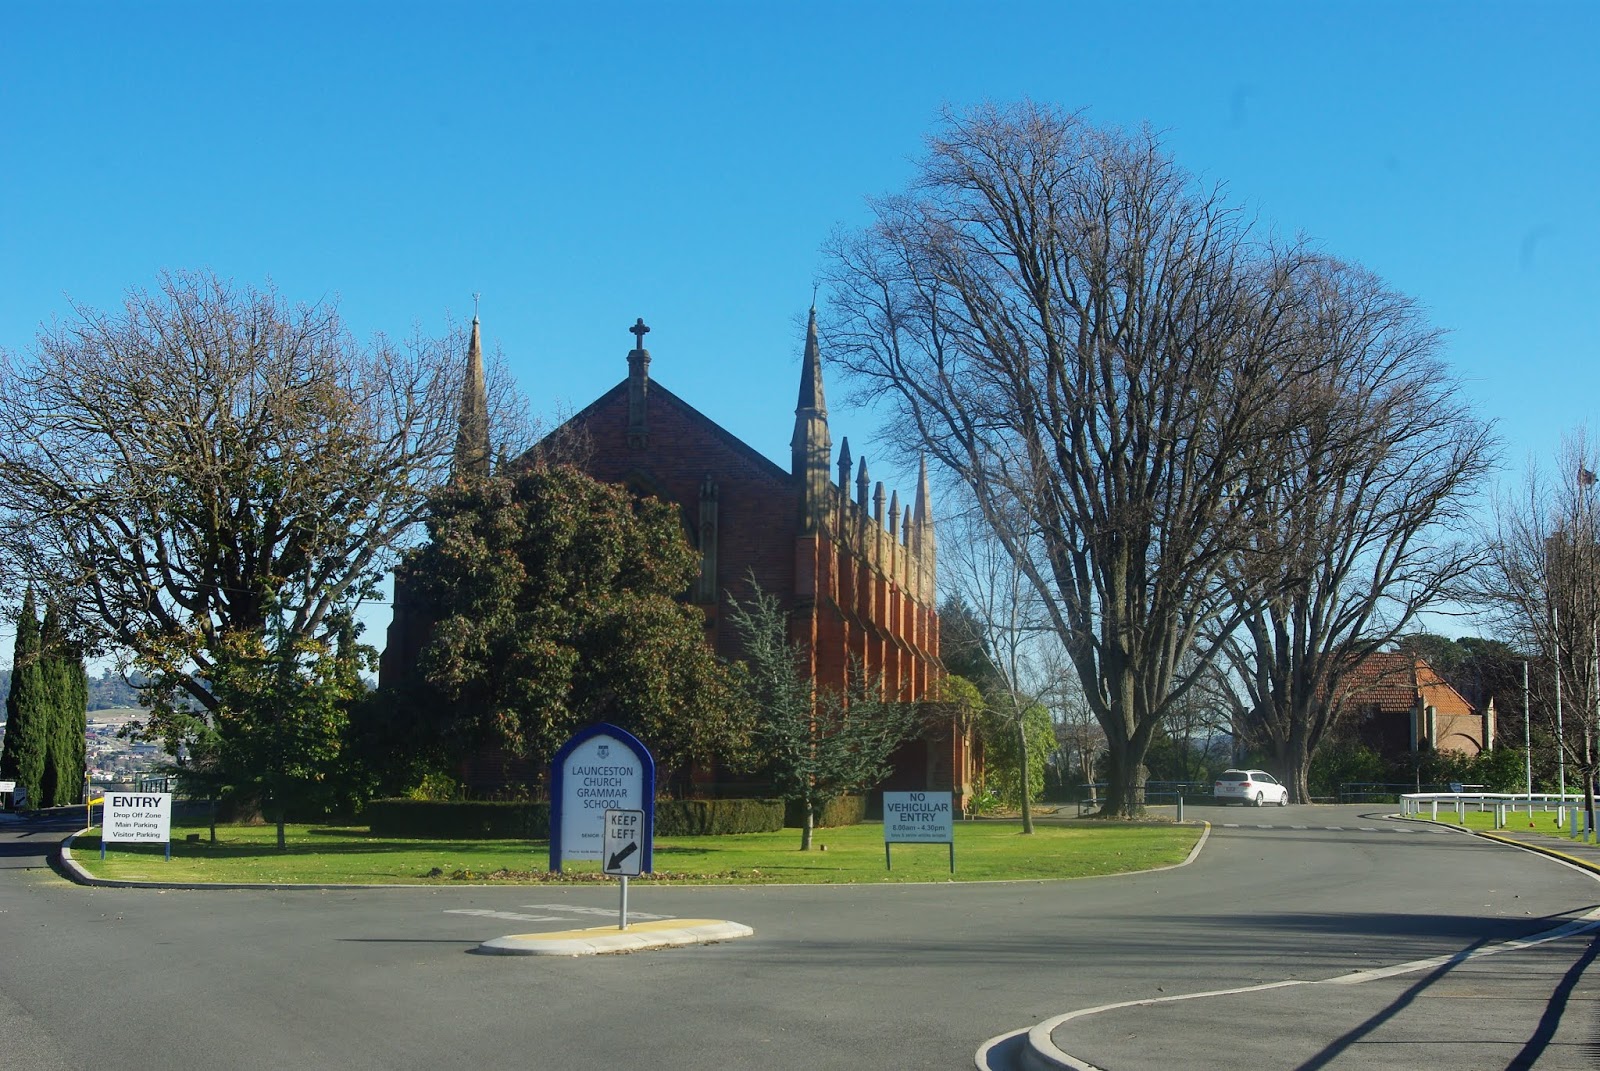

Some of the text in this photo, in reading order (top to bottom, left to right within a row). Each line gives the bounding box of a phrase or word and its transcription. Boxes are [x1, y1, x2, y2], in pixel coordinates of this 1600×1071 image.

[572, 766, 633, 776] LAUNCESTON
[584, 778, 622, 786] CHURCH
[577, 789, 627, 798] GRAMMAR
[910, 793, 925, 801] NO
[113, 797, 162, 807] ENTRY
[584, 800, 621, 809] SCHOOL
[888, 804, 948, 812] VEHICULAR
[612, 816, 637, 826] KEEP
[900, 813, 936, 821] ENTRY
[612, 830, 635, 839] LEFT
